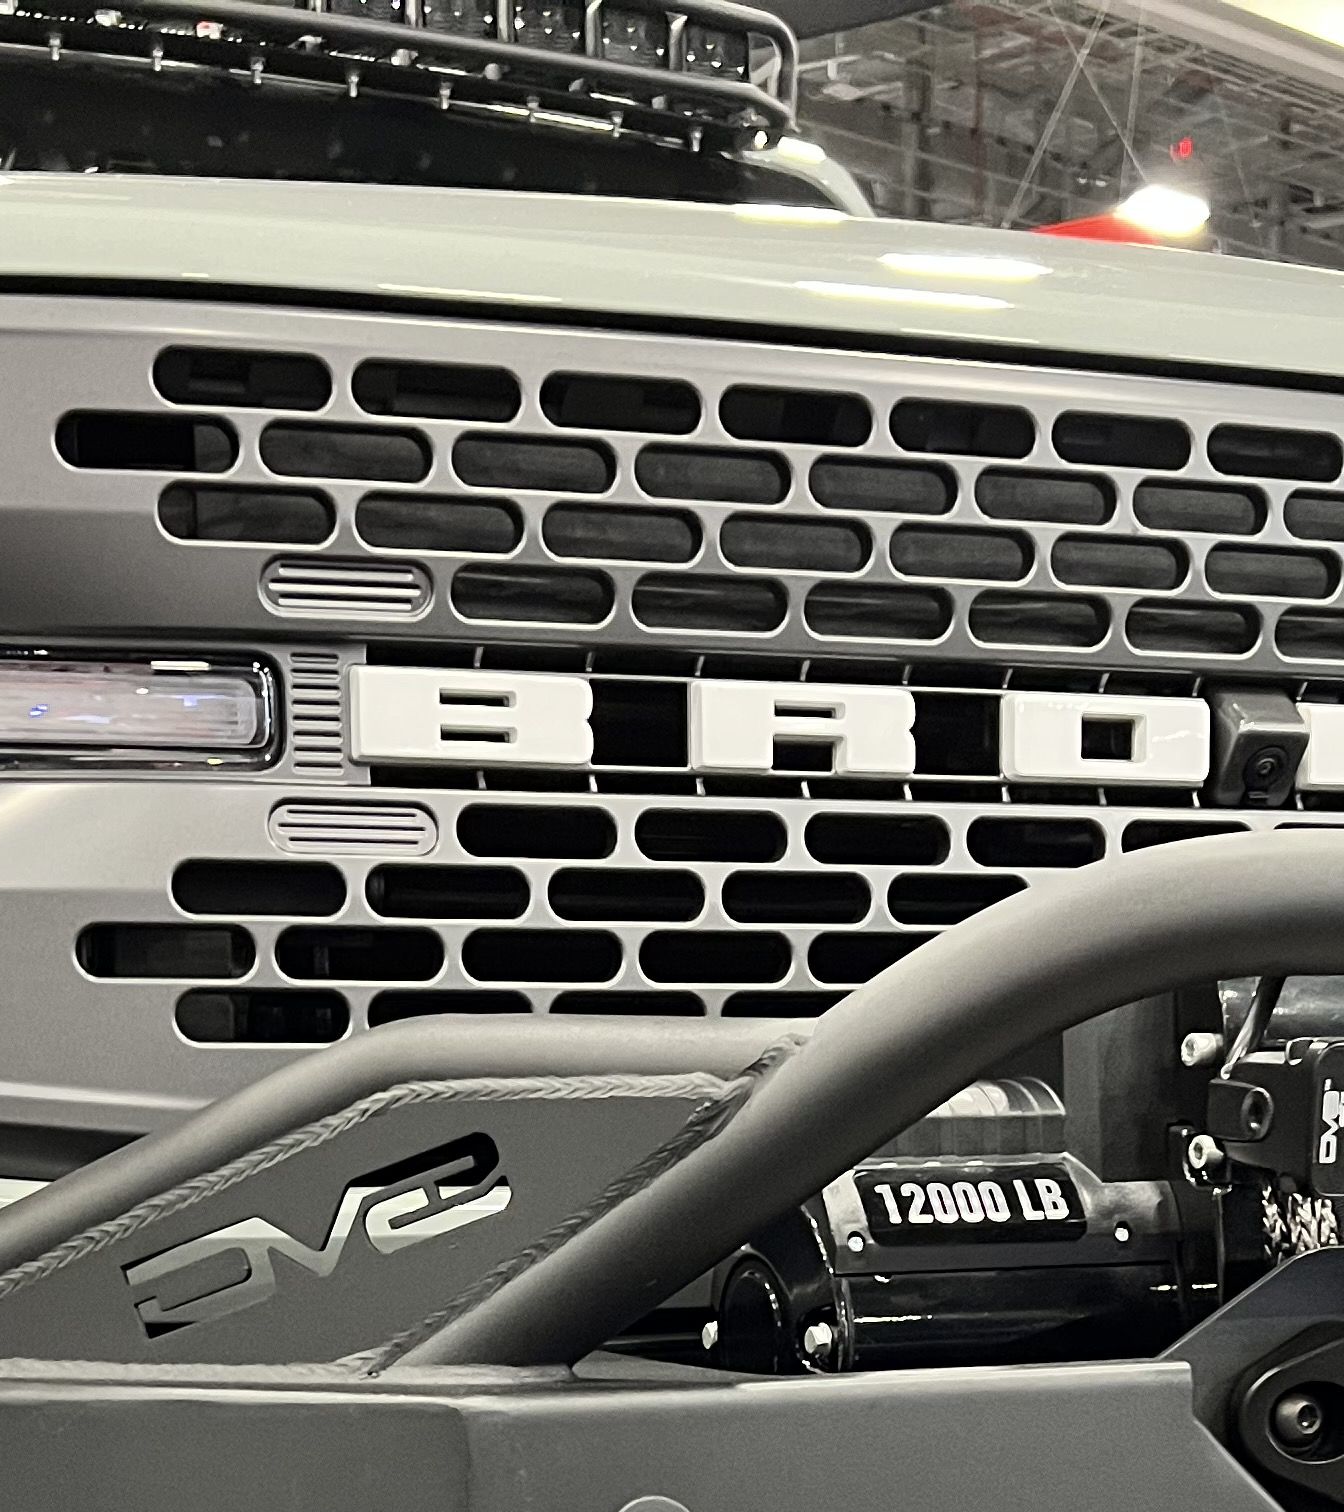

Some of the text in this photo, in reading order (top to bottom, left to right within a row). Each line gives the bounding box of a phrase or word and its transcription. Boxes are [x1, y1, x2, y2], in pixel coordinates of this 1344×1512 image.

[121, 1132, 512, 1338] DV8
[874, 1178, 1069, 1224] 12000 LB
